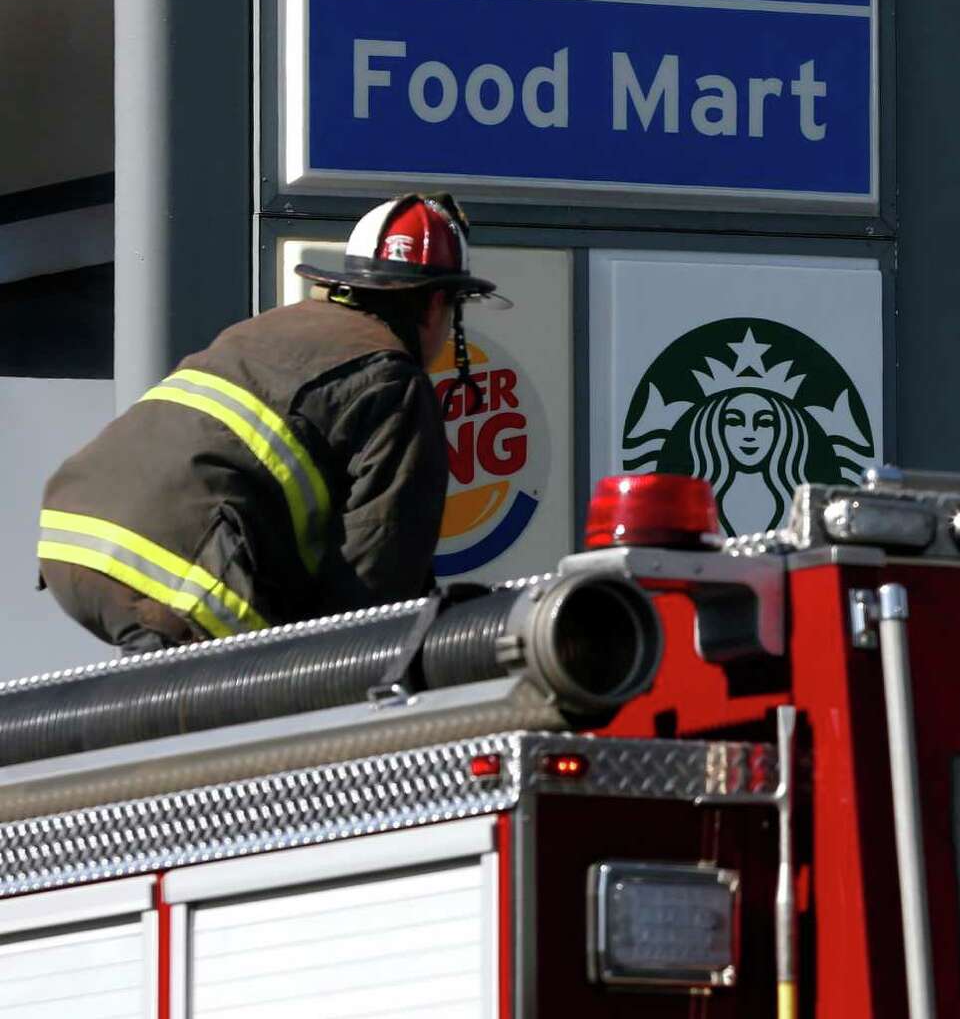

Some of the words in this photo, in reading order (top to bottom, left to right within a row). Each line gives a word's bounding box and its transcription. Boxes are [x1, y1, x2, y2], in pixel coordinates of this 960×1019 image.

[353, 38, 569, 129] Food
[612, 51, 828, 141] Mart
[434, 368, 519, 422] GER
[446, 412, 528, 485] NG
